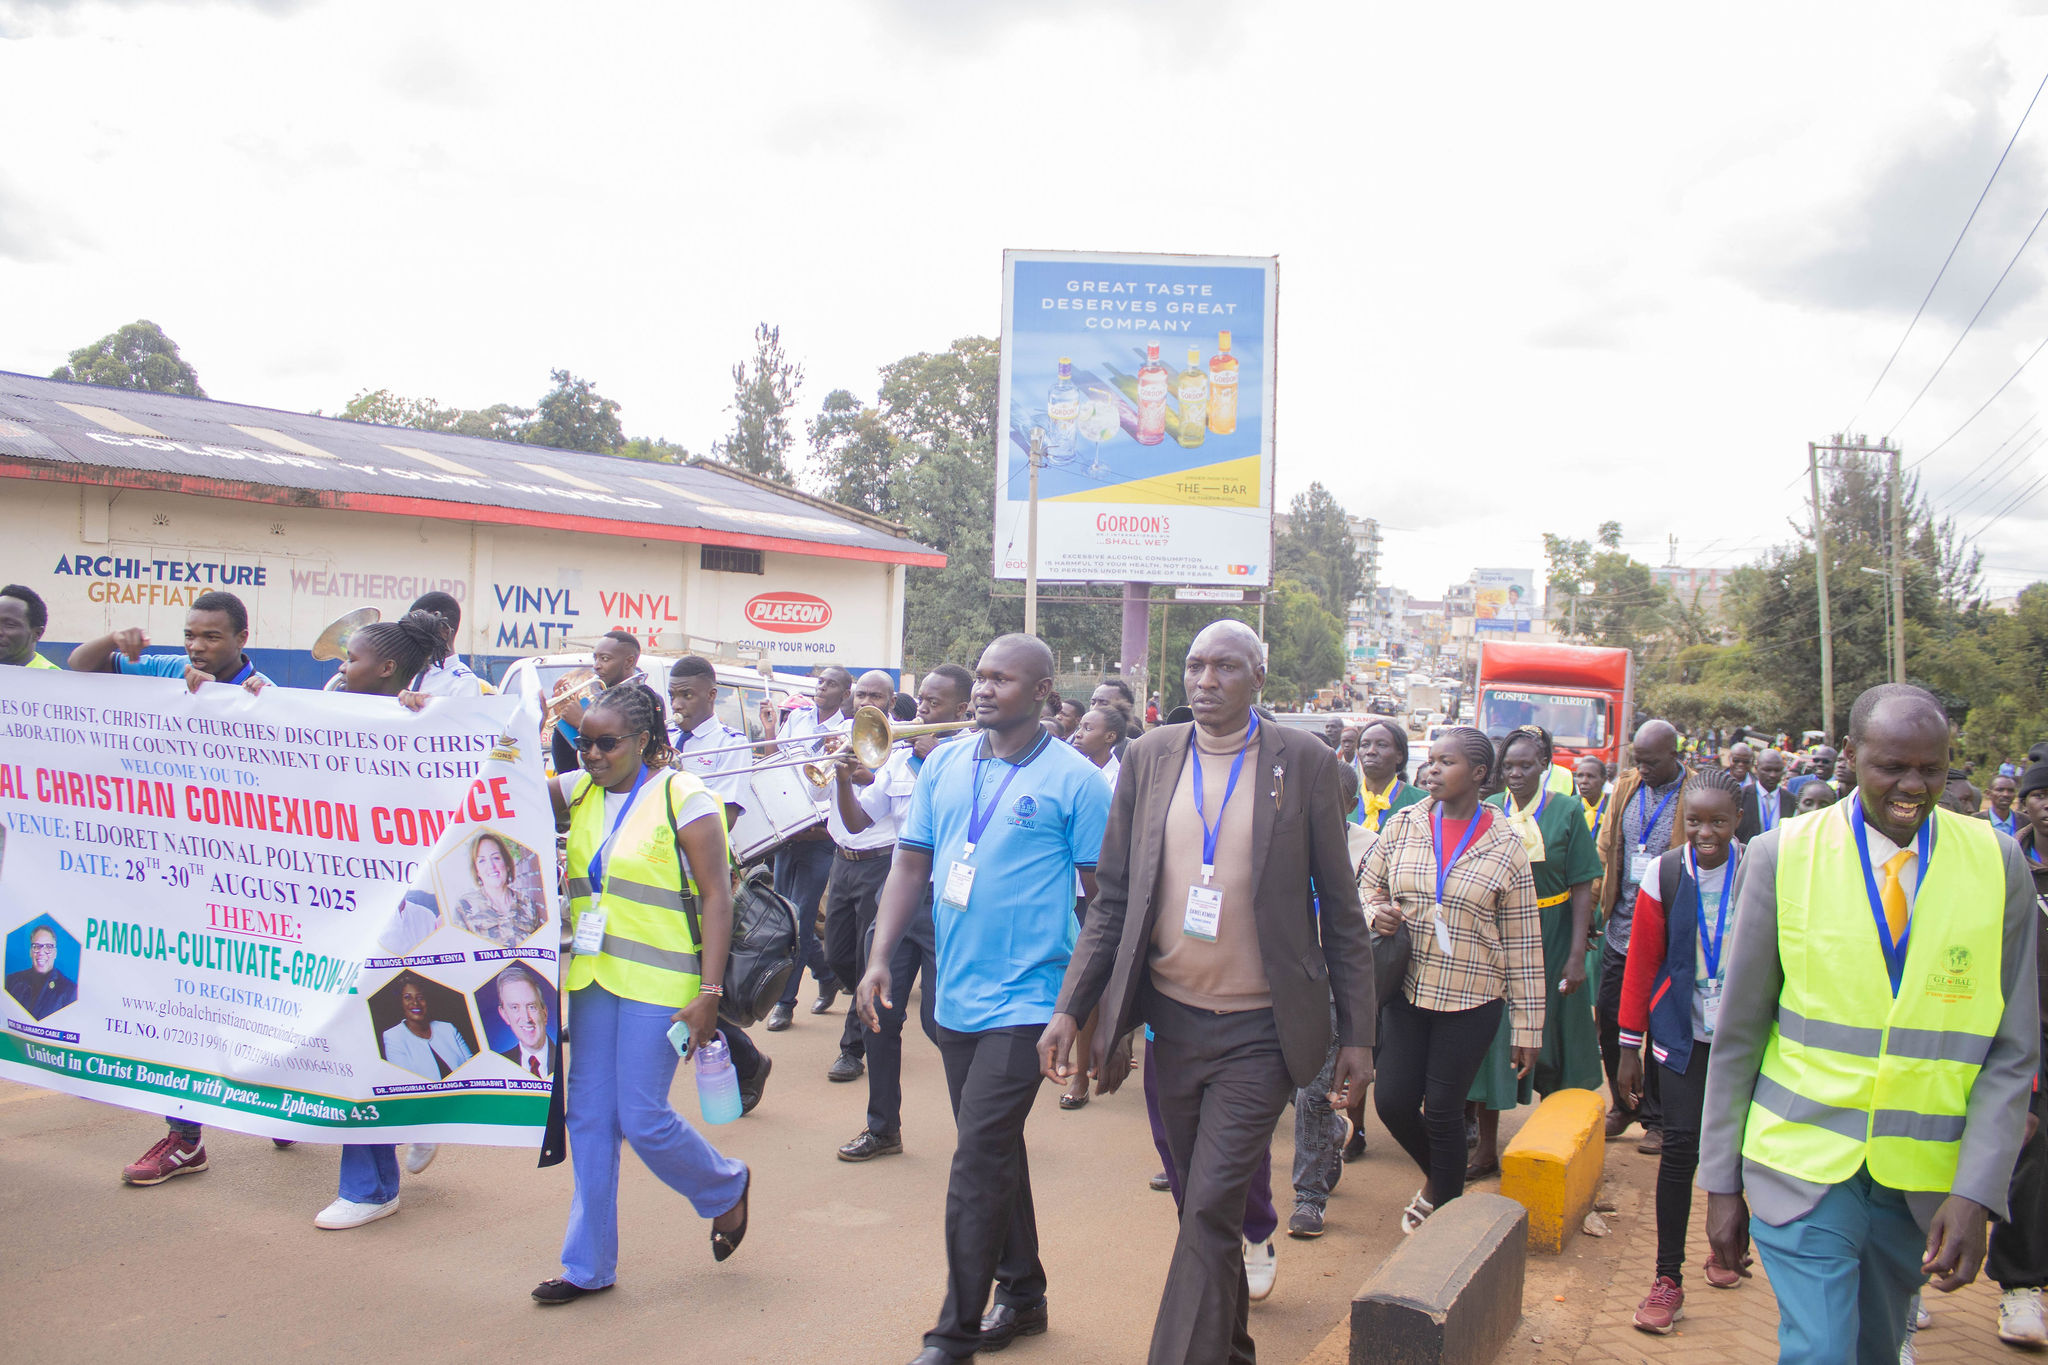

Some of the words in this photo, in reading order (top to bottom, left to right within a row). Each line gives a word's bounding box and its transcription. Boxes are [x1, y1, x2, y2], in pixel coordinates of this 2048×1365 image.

[1066, 280, 1138, 294] GREAT
[1145, 283, 1213, 297] TASTE
[1041, 297, 1158, 313] DESERVES
[1166, 302, 1237, 316] GREAT
[1085, 316, 1193, 332] COMPANY
[86, 432, 328, 470] COLOUR
[1176, 482, 1200, 494] THE
[1222, 484, 1247, 495] BAR
[1096, 512, 1170, 534] GORDON'S
[1144, 538, 1169, 547] WE?
[54, 553, 267, 587] ARCHI-TEXTURE
[1145, 555, 1203, 563] CONSUMPTION
[1227, 564, 1258, 576] UDV
[289, 568, 467, 602] WEATHERGUARD
[493, 583, 580, 616] VINYL
[598, 590, 679, 621] VINYL
[753, 602, 825, 623] PLASCON
[495, 620, 574, 650] MATT
[738, 640, 776, 652] COLOUR
[777, 641, 803, 653] YOUR
[804, 642, 836, 653] WORLD
[1493, 691, 1532, 703] GOSPEL
[1549, 695, 1594, 707] CHARIOT
[0, 699, 18, 716] ES
[21, 701, 40, 717] OF
[102, 708, 183, 733] CHRISTIAN
[186, 717, 281, 743] CHURCHES/
[284, 725, 379, 750] DISCIPLES
[383, 733, 408, 753] OF
[413, 733, 500, 754] CHRIST
[89, 730, 129, 751] WITH
[132, 735, 199, 758] COUNTY
[202, 741, 321, 770] GOVERNMENT
[325, 753, 351, 774] OF
[354, 757, 412, 778] UASIN
[120, 757, 197, 780] WELCOME
[200, 765, 231, 784] YOU
[233, 769, 261, 787] TO:
[35, 767, 177, 819] CHRISTIAN
[184, 784, 361, 843] CONNEXION
[7, 811, 70, 840] VENUE:
[74, 820, 160, 851] ELDORET
[163, 832, 263, 867] NATIONAL
[265, 845, 419, 885] POLYTECHNIC
[59, 849, 120, 878] DATE:
[210, 871, 301, 905] AUGUST
[307, 885, 358, 912] 2025
[205, 902, 303, 940] THEME:
[374, 957, 403, 968] WILMOSE
[403, 956, 435, 966] KIPLAGAT
[440, 952, 464, 963] KENYA
[479, 950, 501, 960] TINA
[502, 949, 540, 958] BRUNNER
[174, 977, 196, 996] TO
[199, 982, 303, 1019] REGISTRATION:
[66, 1033, 78, 1041] USA
[105, 1017, 133, 1036] TEL
[135, 1023, 160, 1041] NO.
[163, 1028, 228, 1053] 0720319916
[286, 1056, 356, 1078] 0100648188
[25, 1042, 65, 1068] United
[67, 1054, 83, 1071] in
[85, 1056, 133, 1081] Christ
[135, 1063, 190, 1091] Bonded
[191, 1076, 223, 1099] with
[279, 1092, 348, 1122] Ephesians
[349, 1104, 381, 1121] 4:3
[375, 1087, 389, 1095] DR.
[427, 1081, 465, 1091] CHIZANGA
[469, 1080, 504, 1088] ZIMBABWE
[521, 1081, 543, 1090] DOUG
